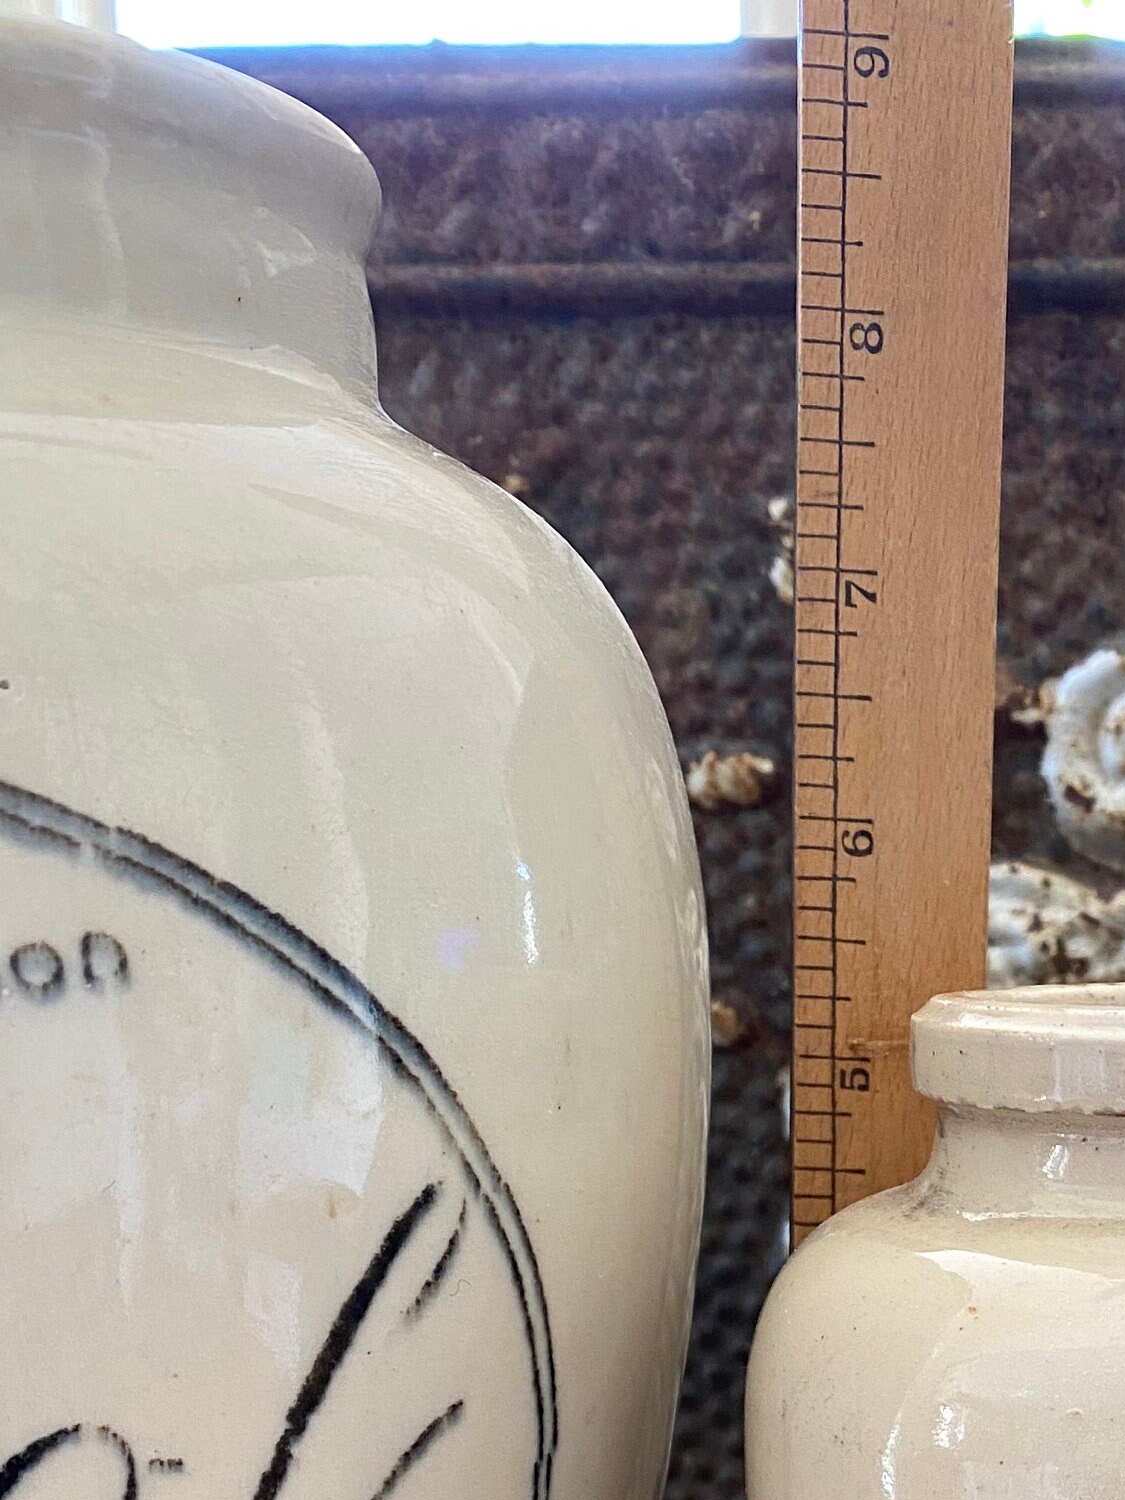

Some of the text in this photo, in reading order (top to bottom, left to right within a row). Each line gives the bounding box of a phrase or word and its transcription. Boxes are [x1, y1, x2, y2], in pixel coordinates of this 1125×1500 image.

[853, 45, 890, 79] 9
[849, 321, 884, 354] 8
[844, 579, 878, 609] 7
[841, 829, 875, 857] 6
[839, 1066, 871, 1092] 5
